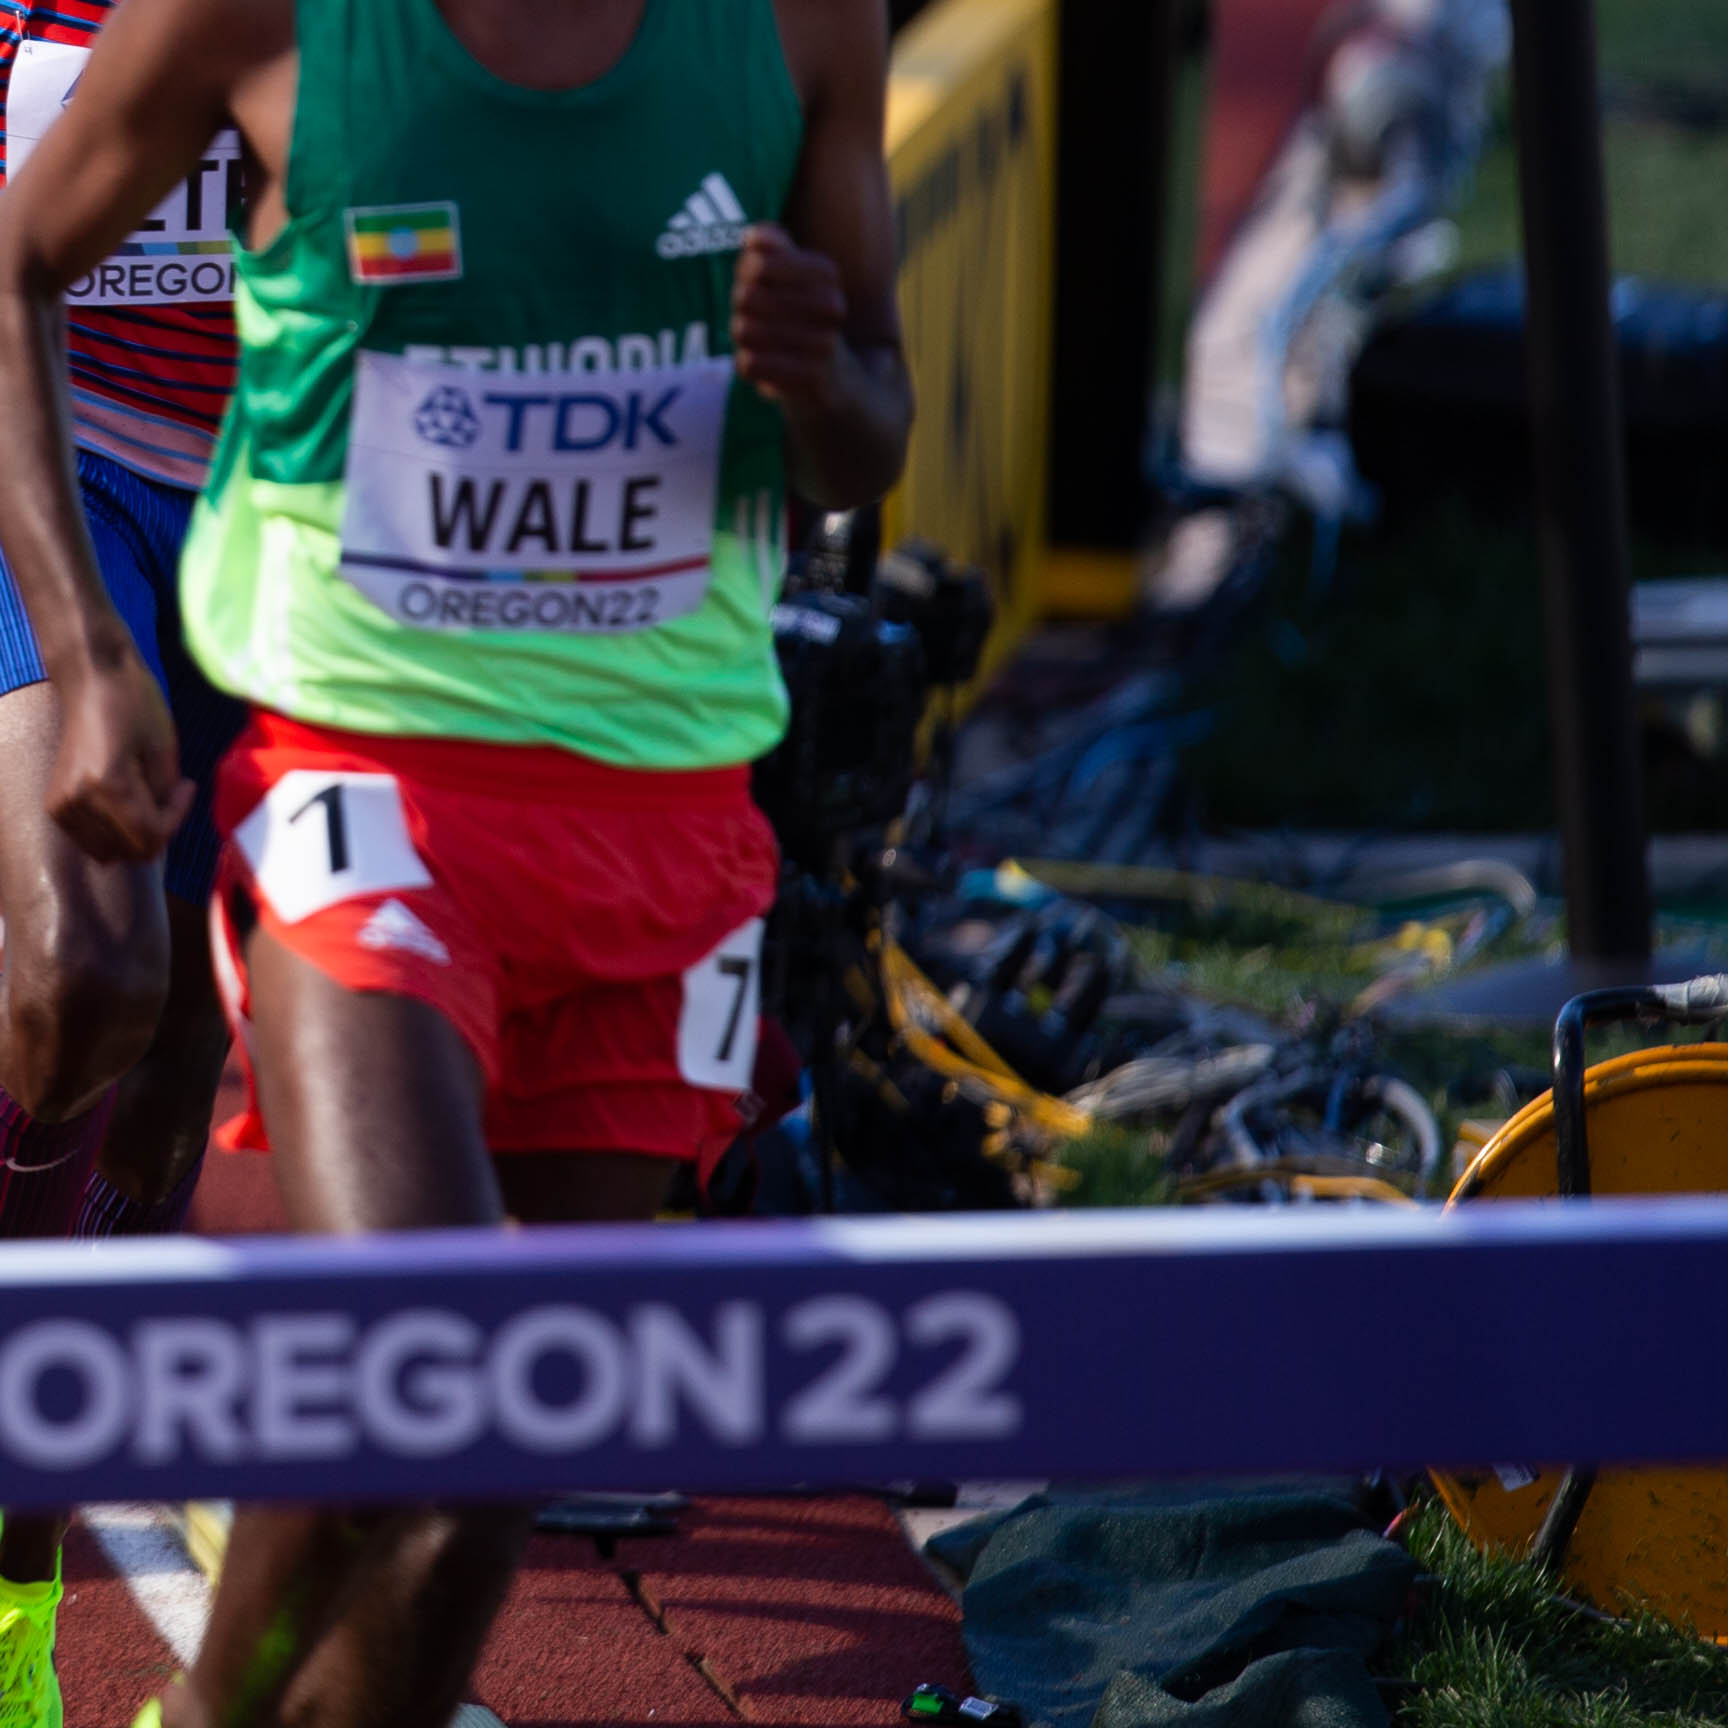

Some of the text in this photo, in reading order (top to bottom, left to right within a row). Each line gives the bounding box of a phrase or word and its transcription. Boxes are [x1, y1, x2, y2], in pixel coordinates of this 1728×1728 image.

[66, 261, 237, 299] OREGO
[484, 384, 684, 453] TDK
[428, 471, 662, 554] WALE
[398, 581, 661, 628] OREGON22
